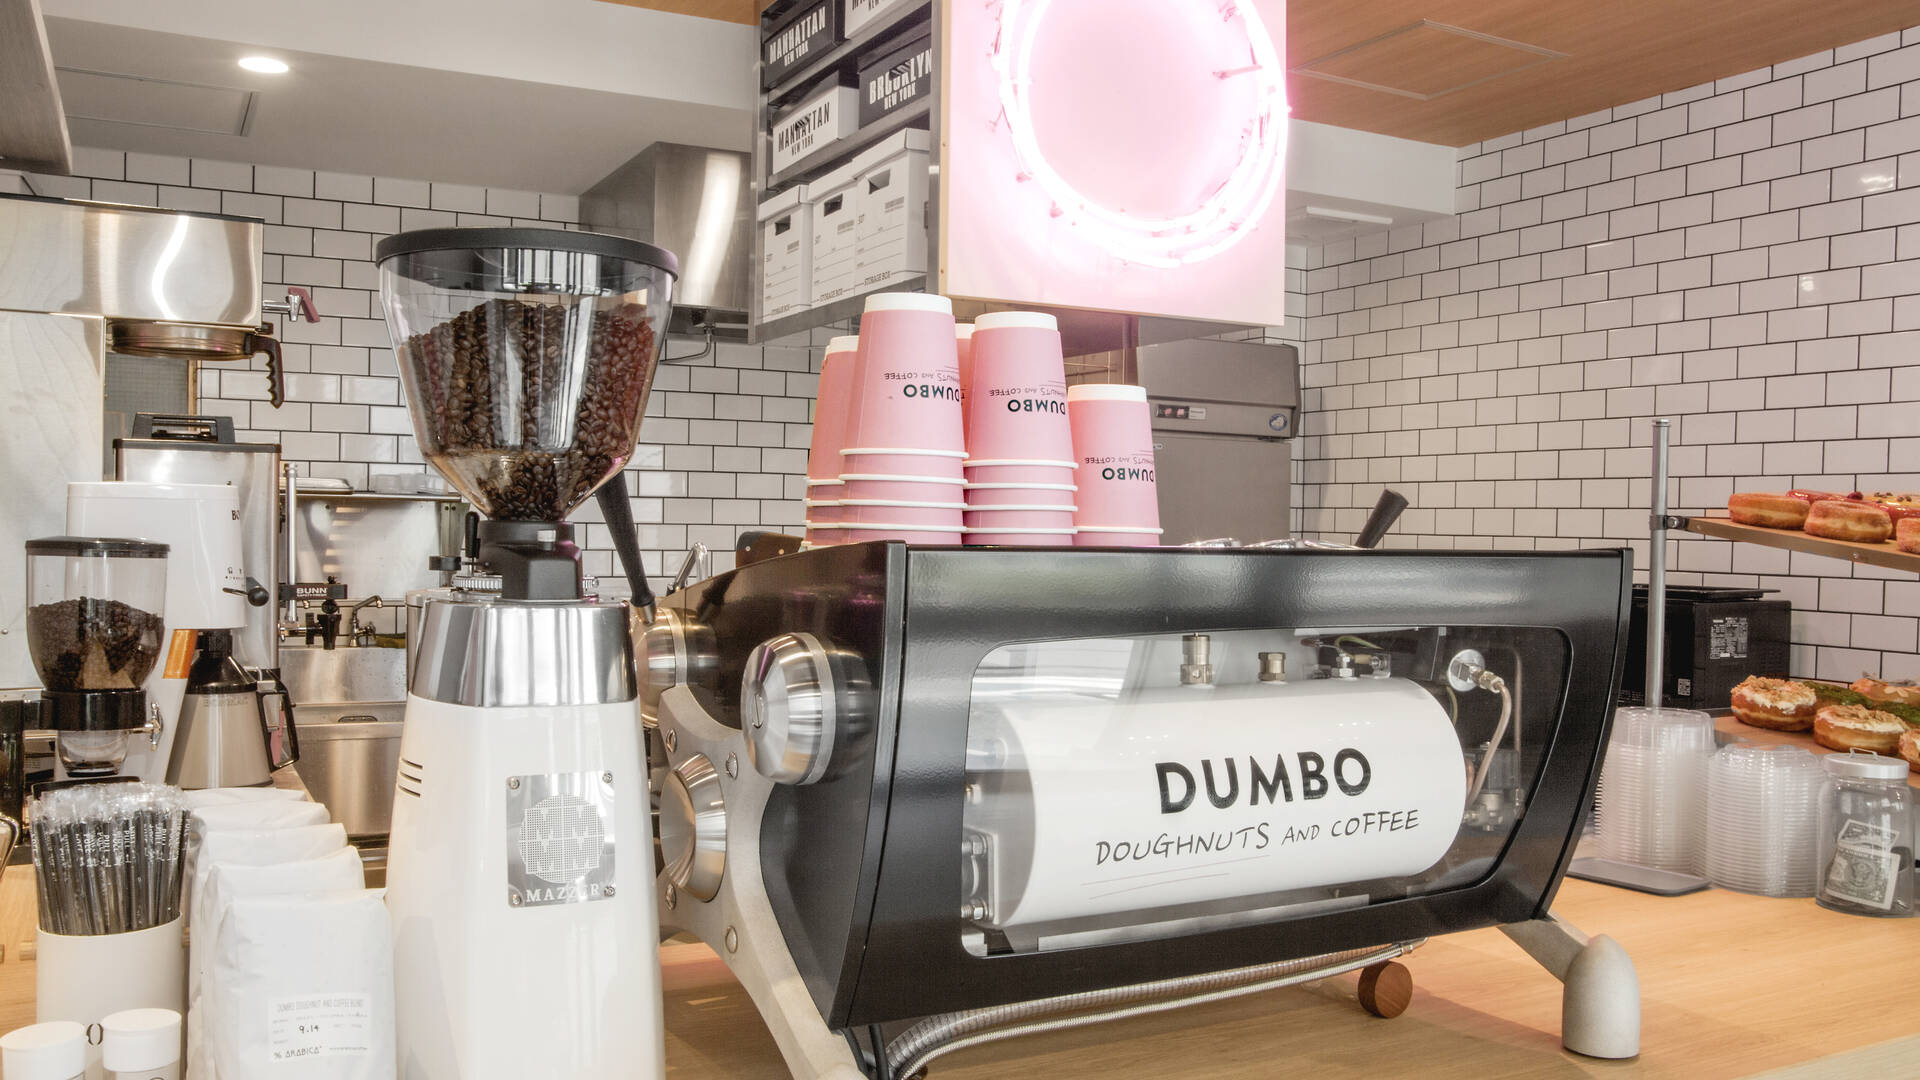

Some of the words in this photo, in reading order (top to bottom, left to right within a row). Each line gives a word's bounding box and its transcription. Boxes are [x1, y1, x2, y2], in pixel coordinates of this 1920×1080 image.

[769, 6, 826, 65] MANHATTAN
[784, 52, 795, 67] NEW
[795, 42, 809, 59] YORK
[883, 92, 898, 110] NEW
[899, 82, 916, 102] YORK
[778, 102, 830, 153] MANHATTAN
[791, 142, 801, 157] NEW
[801, 135, 814, 150] YORK
[884, 372, 918, 380] COFFEE
[903, 384, 960, 402] DUMBO
[989, 388, 1021, 397] COFFEE
[1007, 399, 1066, 415] DUMBO
[1102, 468, 1154, 483] DUMBO
[1154, 747, 1372, 815] DUMBO
[1095, 821, 1271, 866] DOUGHNUTS
[1281, 824, 1321, 846] AND
[1330, 809, 1420, 837] COFFEE
[525, 883, 601, 902] MAZZR
[298, 1024, 320, 1034] 9.14
